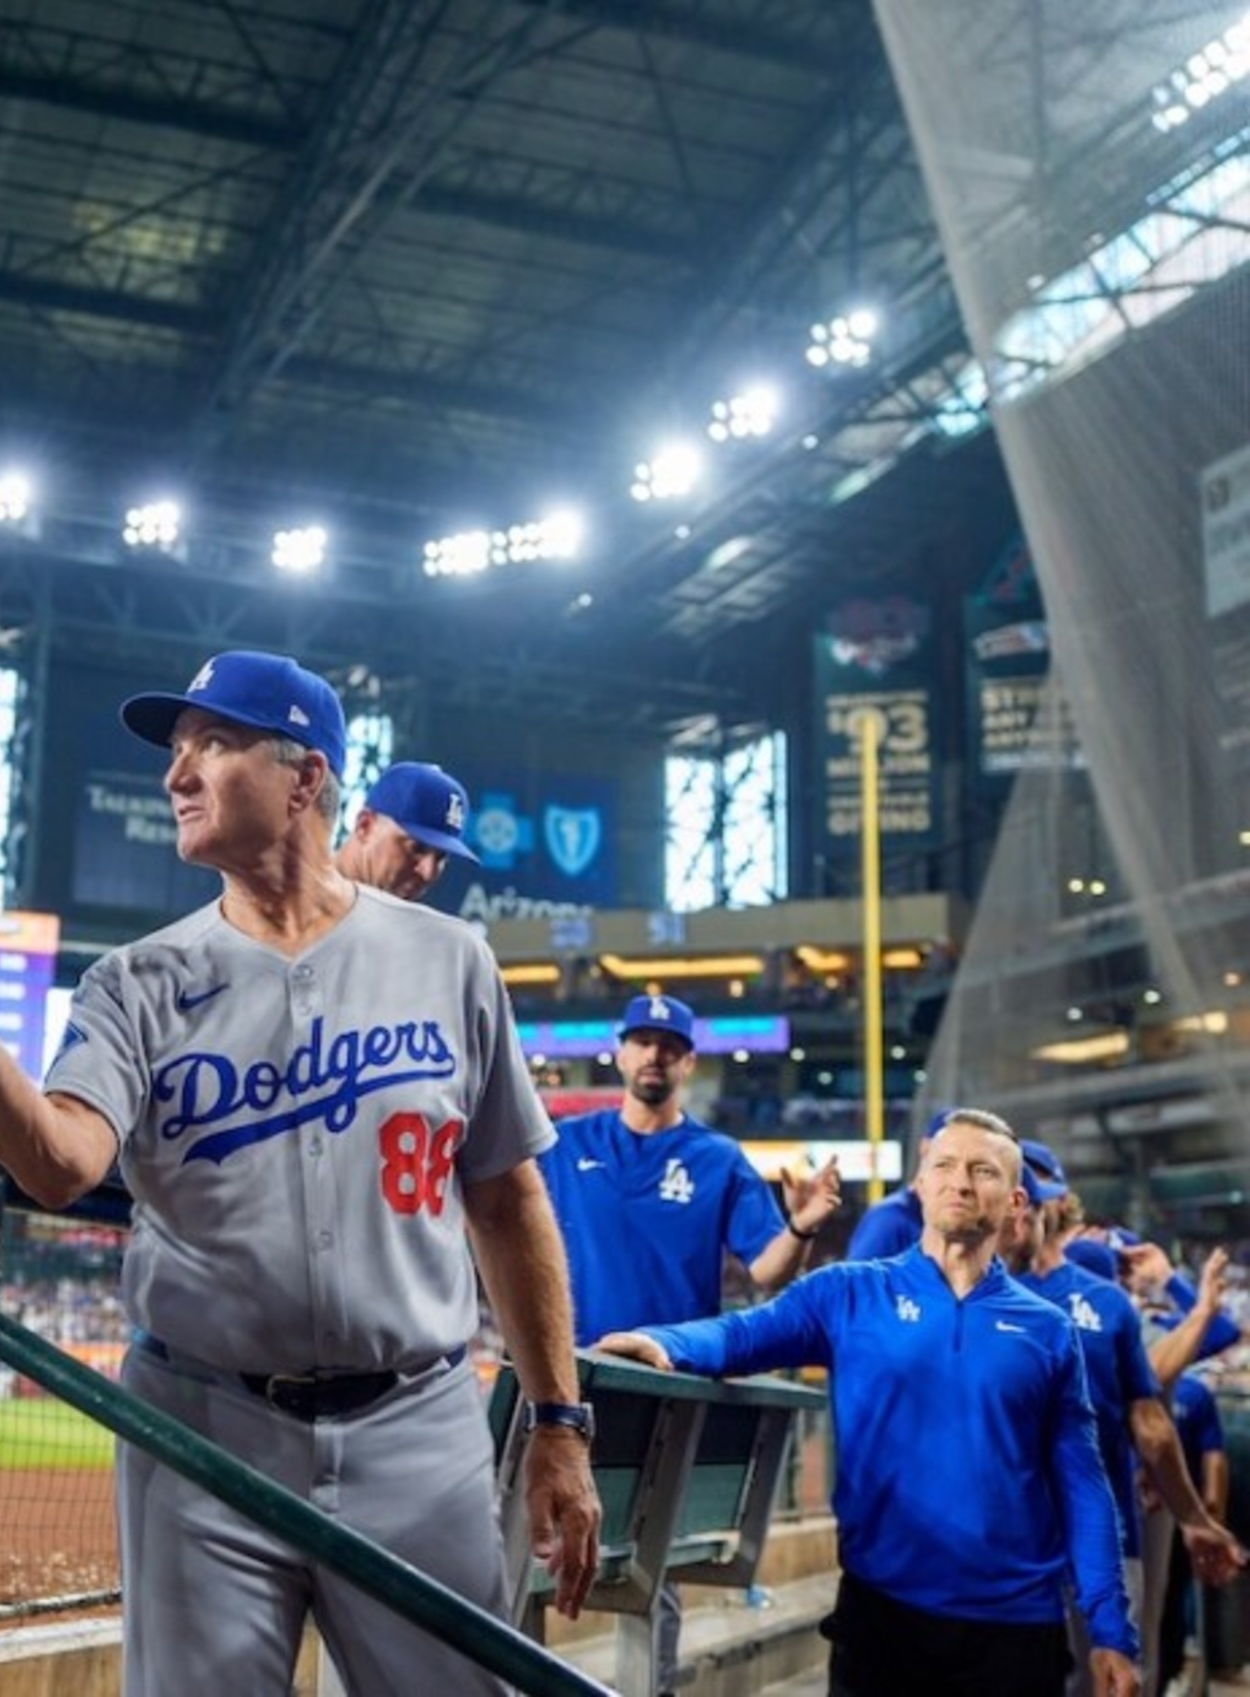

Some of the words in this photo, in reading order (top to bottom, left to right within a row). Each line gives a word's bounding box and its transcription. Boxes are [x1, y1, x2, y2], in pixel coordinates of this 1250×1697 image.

[650, 996, 670, 1020] LA
[156, 1016, 454, 1140] Dodgers
[378, 1112, 464, 1218] 88
[659, 1158, 694, 1203] LA
[897, 1295, 921, 1322] LA
[1068, 1293, 1102, 1332] LA
